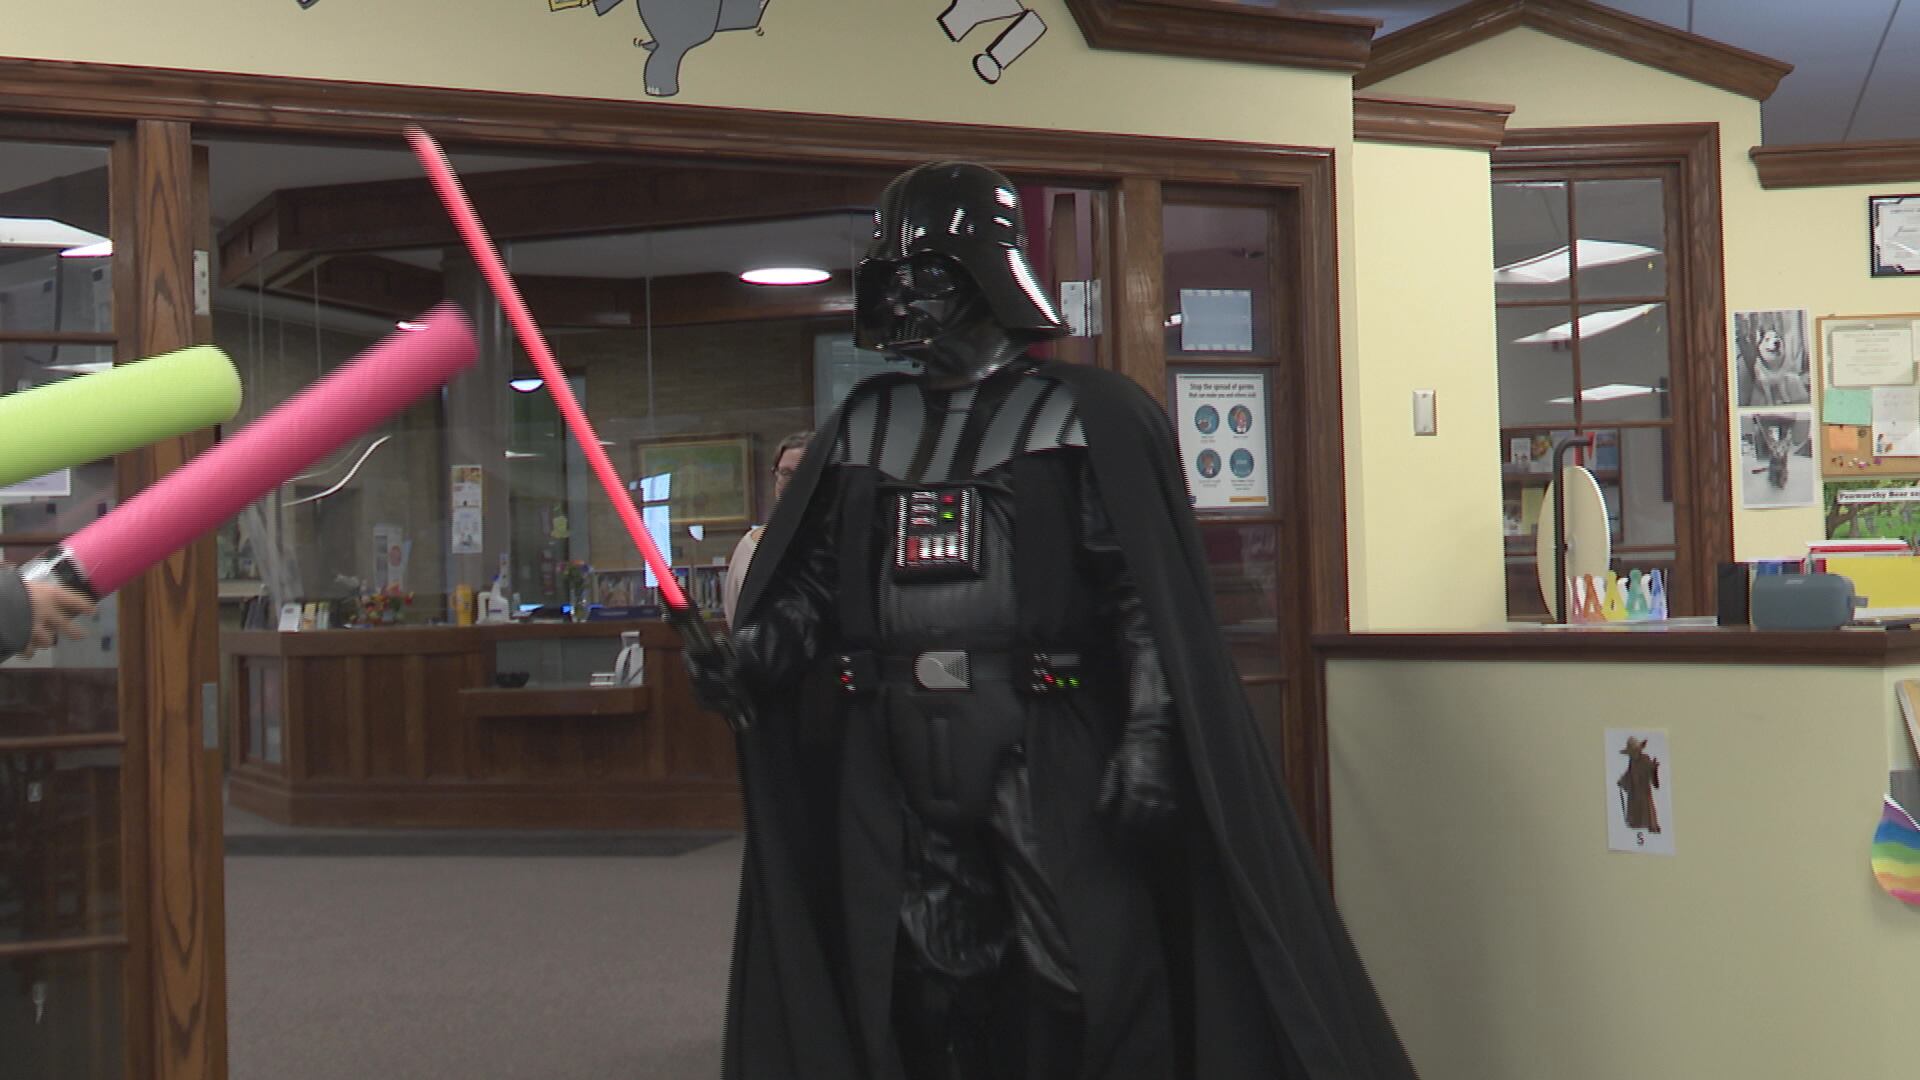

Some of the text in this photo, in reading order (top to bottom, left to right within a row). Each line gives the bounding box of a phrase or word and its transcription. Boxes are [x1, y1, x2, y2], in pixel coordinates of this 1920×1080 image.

[1190, 383, 1202, 392] Stop
[1213, 383, 1231, 391] spread
[1238, 383, 1255, 391] germs
